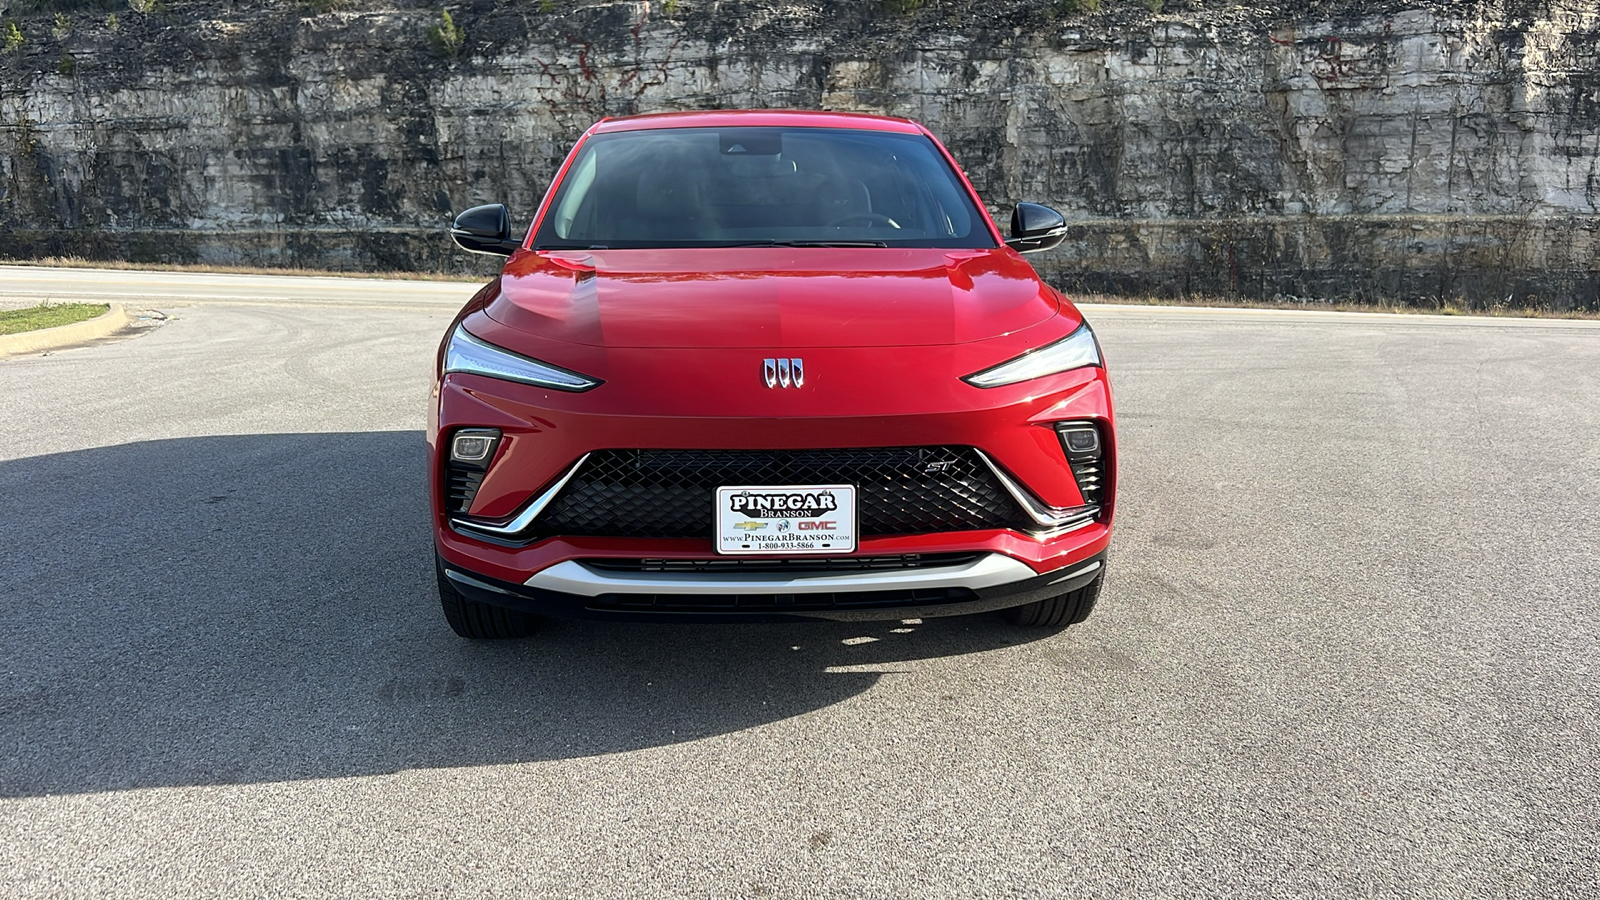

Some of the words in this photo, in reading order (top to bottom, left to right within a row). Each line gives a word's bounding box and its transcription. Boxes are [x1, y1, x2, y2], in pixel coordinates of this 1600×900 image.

[925, 458, 957, 472] ST
[732, 495, 835, 510] PINEGAR
[760, 509, 812, 518] BRANSON
[798, 521, 837, 531] GMC
[758, 542, 814, 550] 1-800-933-5866
